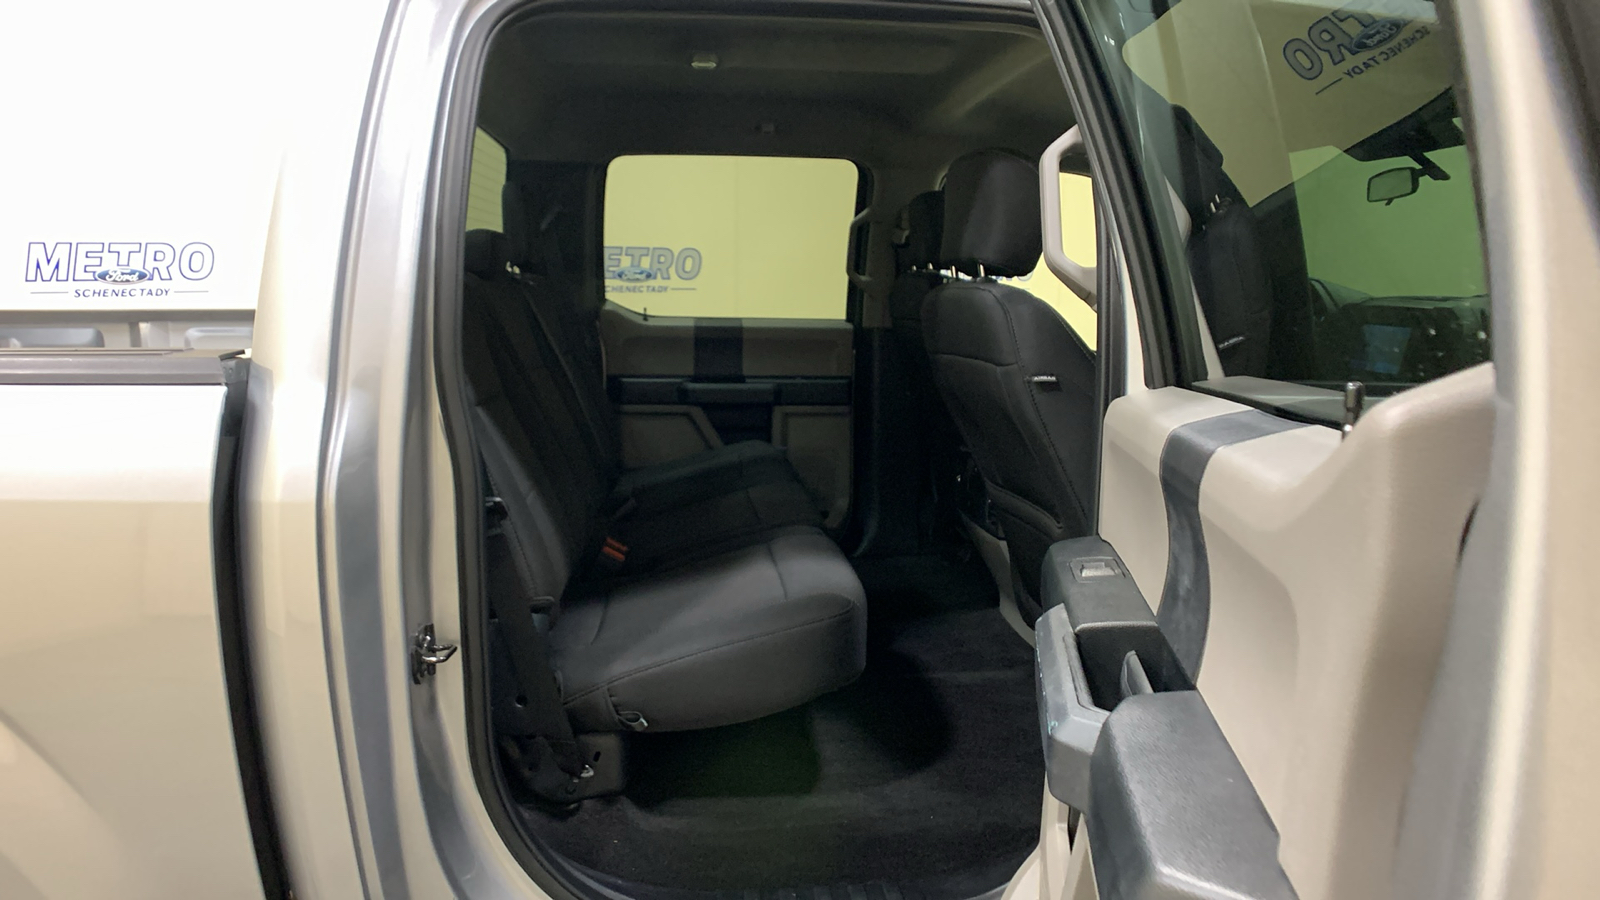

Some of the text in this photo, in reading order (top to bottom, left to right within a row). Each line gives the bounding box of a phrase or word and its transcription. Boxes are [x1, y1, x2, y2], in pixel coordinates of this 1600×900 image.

[25, 241, 215, 282] METRO
[604, 246, 702, 281] ETRO
[105, 268, 139, 282] Ford
[74, 288, 171, 298] SCHENECTADY
[604, 285, 668, 294] CHENECTADY
